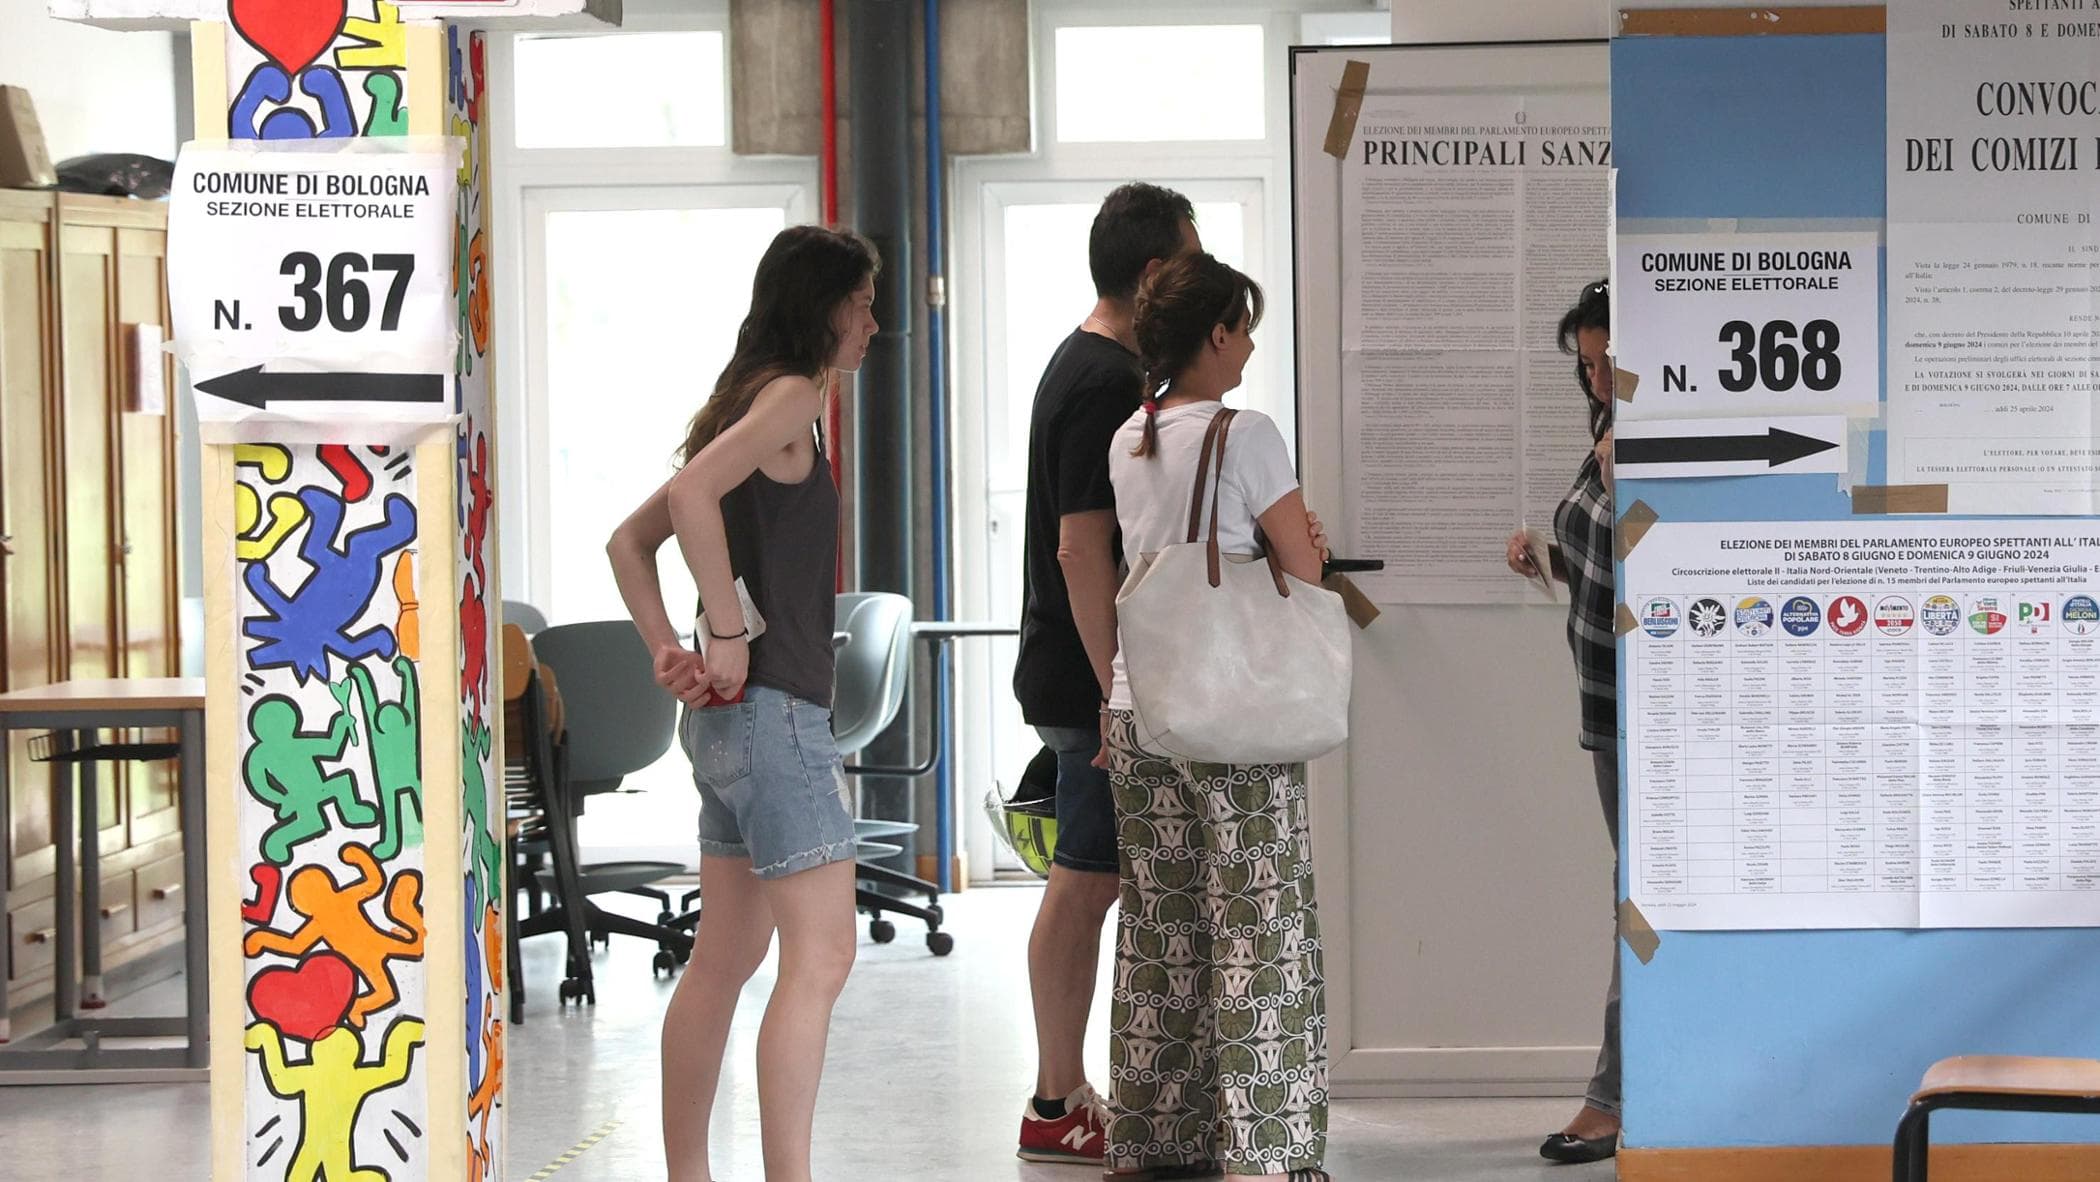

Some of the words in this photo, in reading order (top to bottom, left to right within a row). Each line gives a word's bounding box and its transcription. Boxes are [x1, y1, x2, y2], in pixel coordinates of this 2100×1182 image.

[2010, 0, 2082, 10] SPETTANTI
[1943, 25, 1955, 38] DI
[1965, 24, 2017, 37] SABATO
[2026, 24, 2032, 37] 8
[2041, 24, 2048, 37] E
[1977, 82, 2100, 115] CONVOC
[1363, 126, 1405, 135] ELEZIONE
[1407, 126, 1421, 135] DEI
[1424, 126, 1458, 135] MEMBRI
[1461, 126, 1475, 135] DEL
[1480, 126, 1538, 135] PARLAMENTO
[1540, 127, 1580, 135] EUROPEO
[1582, 127, 1609, 135] SPETT
[1364, 141, 1525, 165] PRINCIPALI
[1541, 141, 1610, 165] SANZ
[1906, 139, 1953, 171] DEI
[1972, 138, 2077, 171] COMIZI
[194, 173, 288, 194] COMUNE
[297, 174, 317, 195] DI
[327, 175, 429, 195] BOLOGNA
[207, 202, 289, 217] SEZIONE
[296, 204, 414, 218] ELETTORALE
[2017, 214, 2068, 224] COMUNE
[2078, 214, 2090, 223] DI
[1642, 252, 1726, 272] COMUNE
[1732, 252, 1751, 272] DI
[1759, 251, 1851, 270] BOLOGNA
[1655, 279, 1726, 291] SEZIONE
[1732, 277, 1838, 290] ELETTORALE
[215, 300, 251, 330] N.
[278, 252, 414, 332] 367
[1664, 365, 1697, 392] N.
[1719, 319, 1841, 392] 368
[2002, 384, 2020, 392] 2024,
[1721, 540, 1771, 549] ELEZIONE
[1775, 540, 1791, 549] DEI
[1794, 539, 1837, 548] MEMBRI
[1840, 539, 1860, 548] DEL
[1863, 539, 1937, 548] PARLAMENTO
[1940, 538, 1991, 547] EUROPEO
[1993, 538, 2051, 547] SPETTANTI
[1785, 552, 1795, 561] DI
[1798, 552, 1840, 561] SABATO
[1852, 551, 1895, 560] GIUGNO
[1899, 551, 1904, 560] E
[1907, 551, 1965, 560] DOMENICA
[1977, 550, 2018, 559] GIUGNO
[2023, 550, 2050, 559] 2024
[1972, 566, 1997, 575] Adige
[2063, 565, 2087, 573] Giulia
